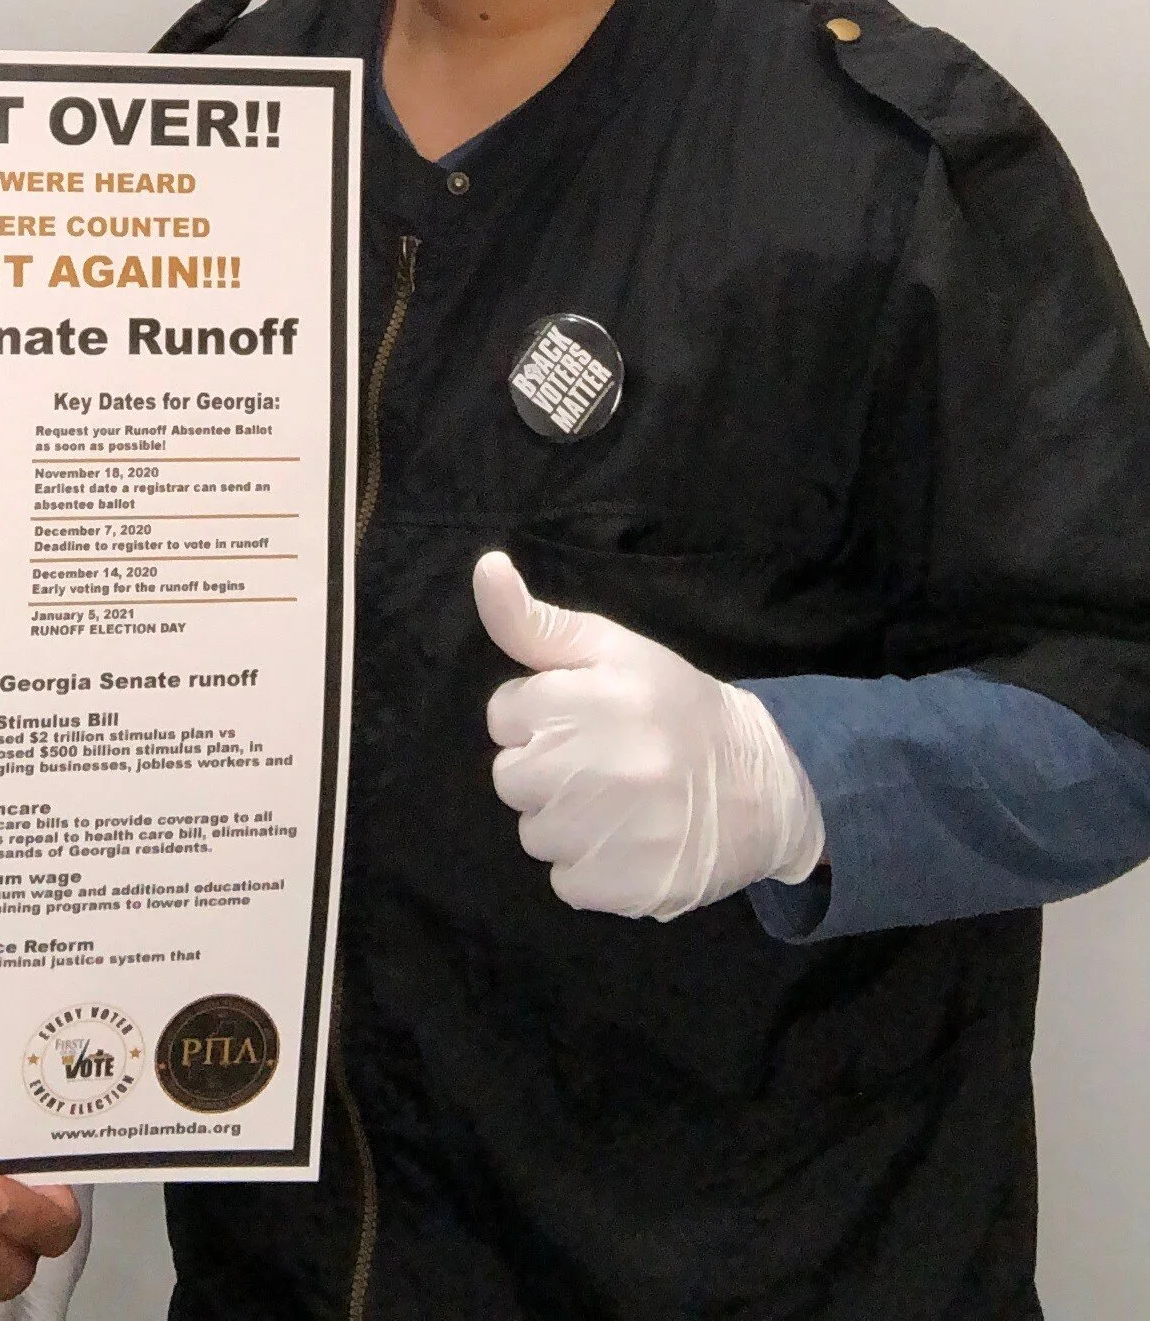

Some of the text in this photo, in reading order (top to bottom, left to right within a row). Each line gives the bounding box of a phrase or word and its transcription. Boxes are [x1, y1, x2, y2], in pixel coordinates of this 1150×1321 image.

[48, 98, 281, 149] OVER!!
[0, 171, 84, 193] WERE
[94, 172, 196, 194] HEARD
[66, 216, 210, 238] COUNTED
[48, 256, 241, 289] AGAIN!!!
[129, 318, 298, 355] Runoff
[532, 342, 592, 413] VOTERS
[54, 392, 280, 414] Key Dates for Georgia:
[550, 359, 613, 434] MATTER
[36, 424, 272, 438] Request your Runoff Absentee Ballot
[36, 440, 166, 452] as soon as possible!
[35, 468, 159, 480] November 18, 2020
[34, 482, 270, 495] Earliest date a registrar can send an
[34, 499, 135, 510] absentee ballot
[34, 524, 152, 537] December 7, 2020
[34, 538, 268, 552] Deadline to register to vote in runoff
[32, 567, 158, 580] December 14, 2020
[32, 581, 245, 596] Early voting for the runoff begins
[32, 609, 134, 622] January 5, 2021
[31, 622, 186, 636] RUNOFF ELECTION DAY
[0, 674, 90, 695] Georgia
[100, 672, 181, 689] Senate
[189, 669, 258, 687] runoff
[88, 713, 118, 727] Bill
[30, 732, 48, 744] $2
[54, 730, 104, 742] trillion
[110, 730, 175, 741] stimulus
[181, 729, 213, 741] plan
[219, 730, 236, 738] vs
[40, 746, 77, 758] $500
[83, 745, 130, 756] billion
[136, 743, 201, 755] stimulus
[207, 742, 243, 755] plan,
[250, 741, 263, 752] in
[40, 760, 131, 772] businesses,
[137, 758, 192, 773] jobless
[198, 757, 259, 768] workers
[265, 755, 293, 766] and
[29, 873, 82, 886] wage
[31, 888, 72, 900] wage
[78, 885, 106, 897] and
[112, 883, 189, 895] additional
[195, 879, 285, 893] educational
[24, 939, 94, 953] Reform
[65, 1049, 114, 1079] VOTE
[51, 1122, 241, 1141] www.rhopilambda.org
